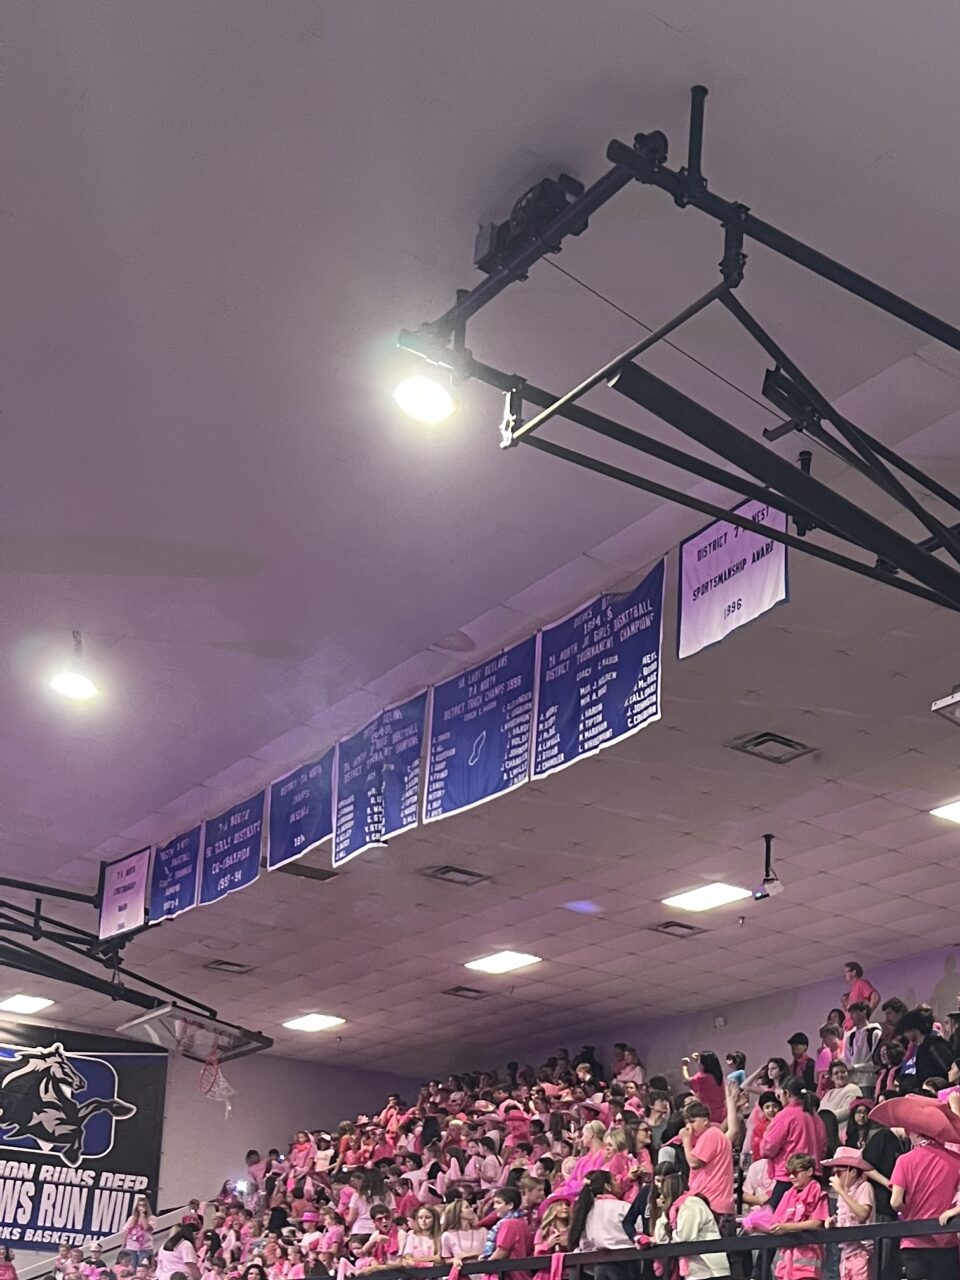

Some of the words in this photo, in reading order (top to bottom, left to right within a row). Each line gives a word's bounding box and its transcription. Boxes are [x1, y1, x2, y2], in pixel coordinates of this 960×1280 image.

[697, 531, 728, 562] DISTRICT
[751, 505, 770, 523] WEST
[692, 558, 747, 601] SPORTSMANSHIP
[751, 540, 775, 565] AWARD
[724, 598, 743, 620] 1996
[39, 1165, 96, 1187] RUNS
[99, 1172, 148, 1191] DEEP
[37, 1183, 89, 1230] RUN
